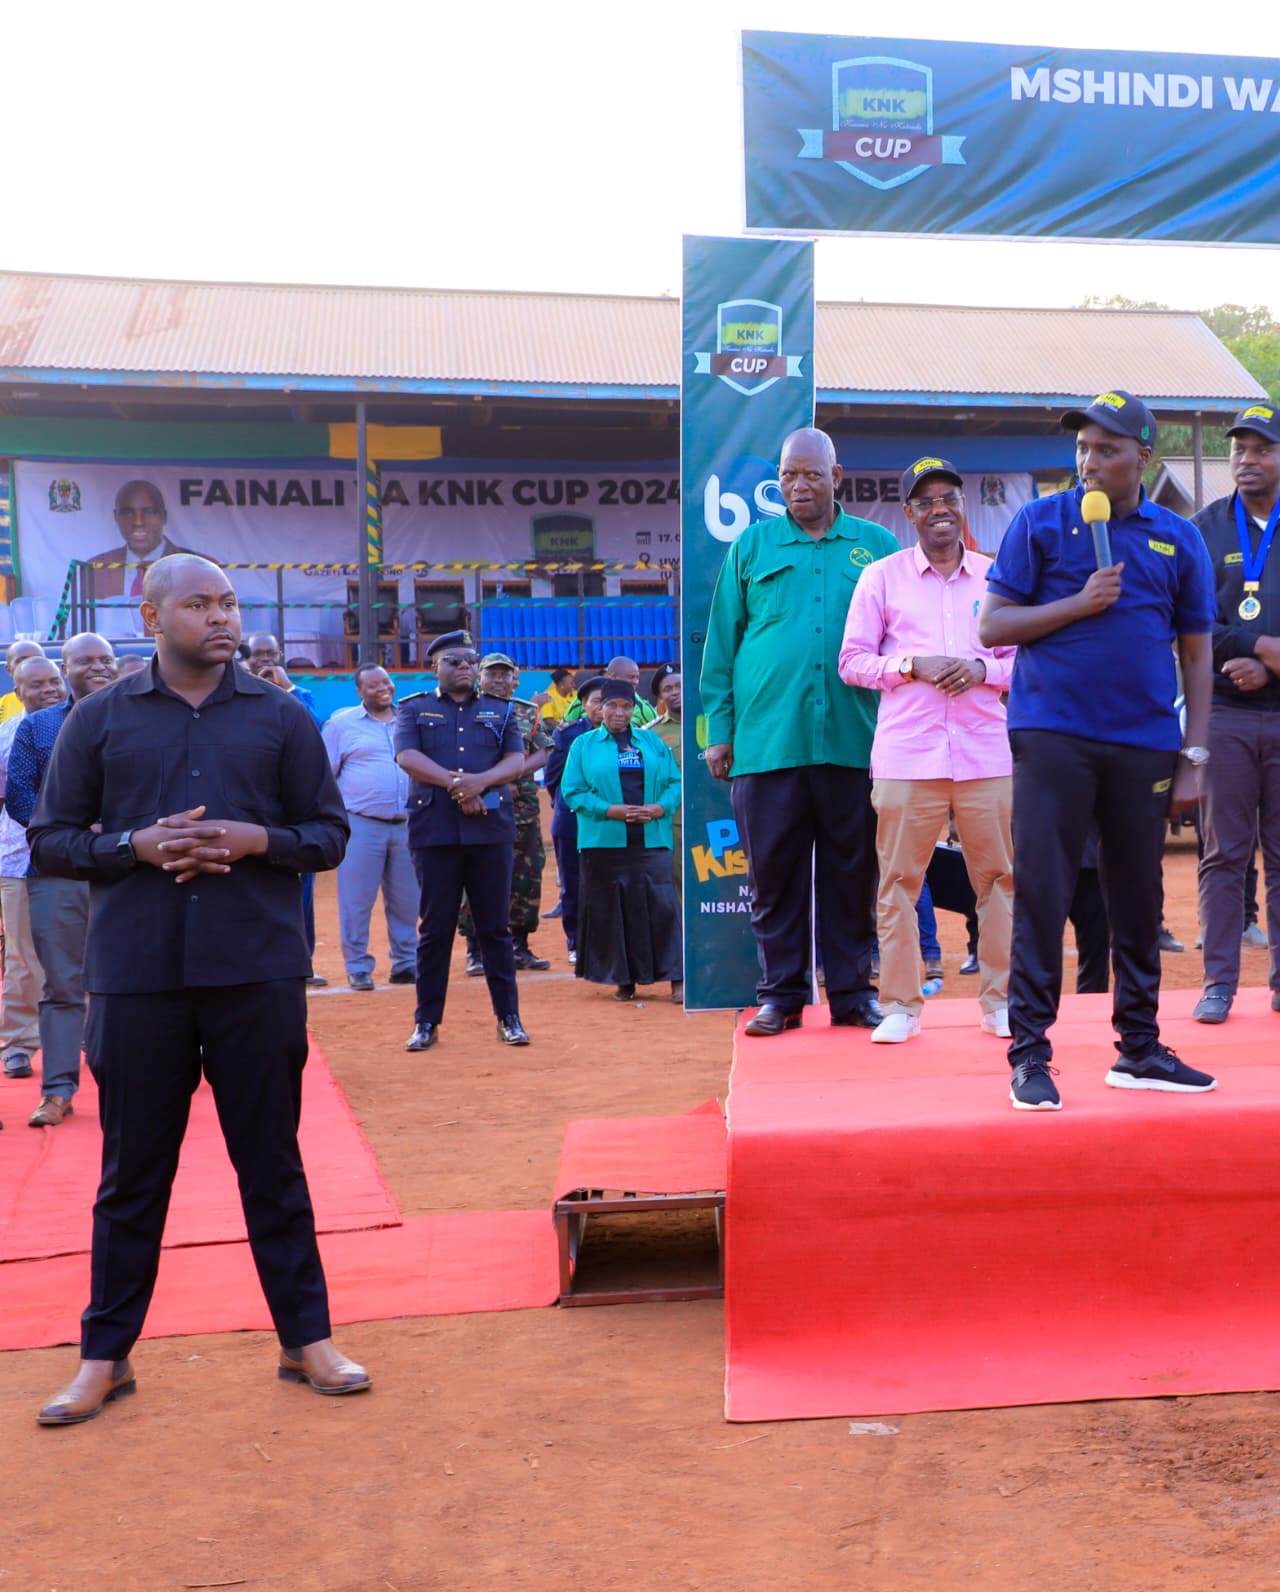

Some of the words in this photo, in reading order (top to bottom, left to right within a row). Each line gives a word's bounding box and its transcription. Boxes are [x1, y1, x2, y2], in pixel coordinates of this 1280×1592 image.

[1010, 66, 1213, 109] MSHINDI
[863, 97, 906, 113] KNK
[855, 136, 912, 159] CUP
[736, 329, 764, 340] KNK
[731, 357, 768, 373] CUP
[179, 479, 345, 506] FAINALI
[419, 479, 504, 506] KNK
[512, 478, 589, 506] CUP
[700, 902, 753, 914] NISHAT
